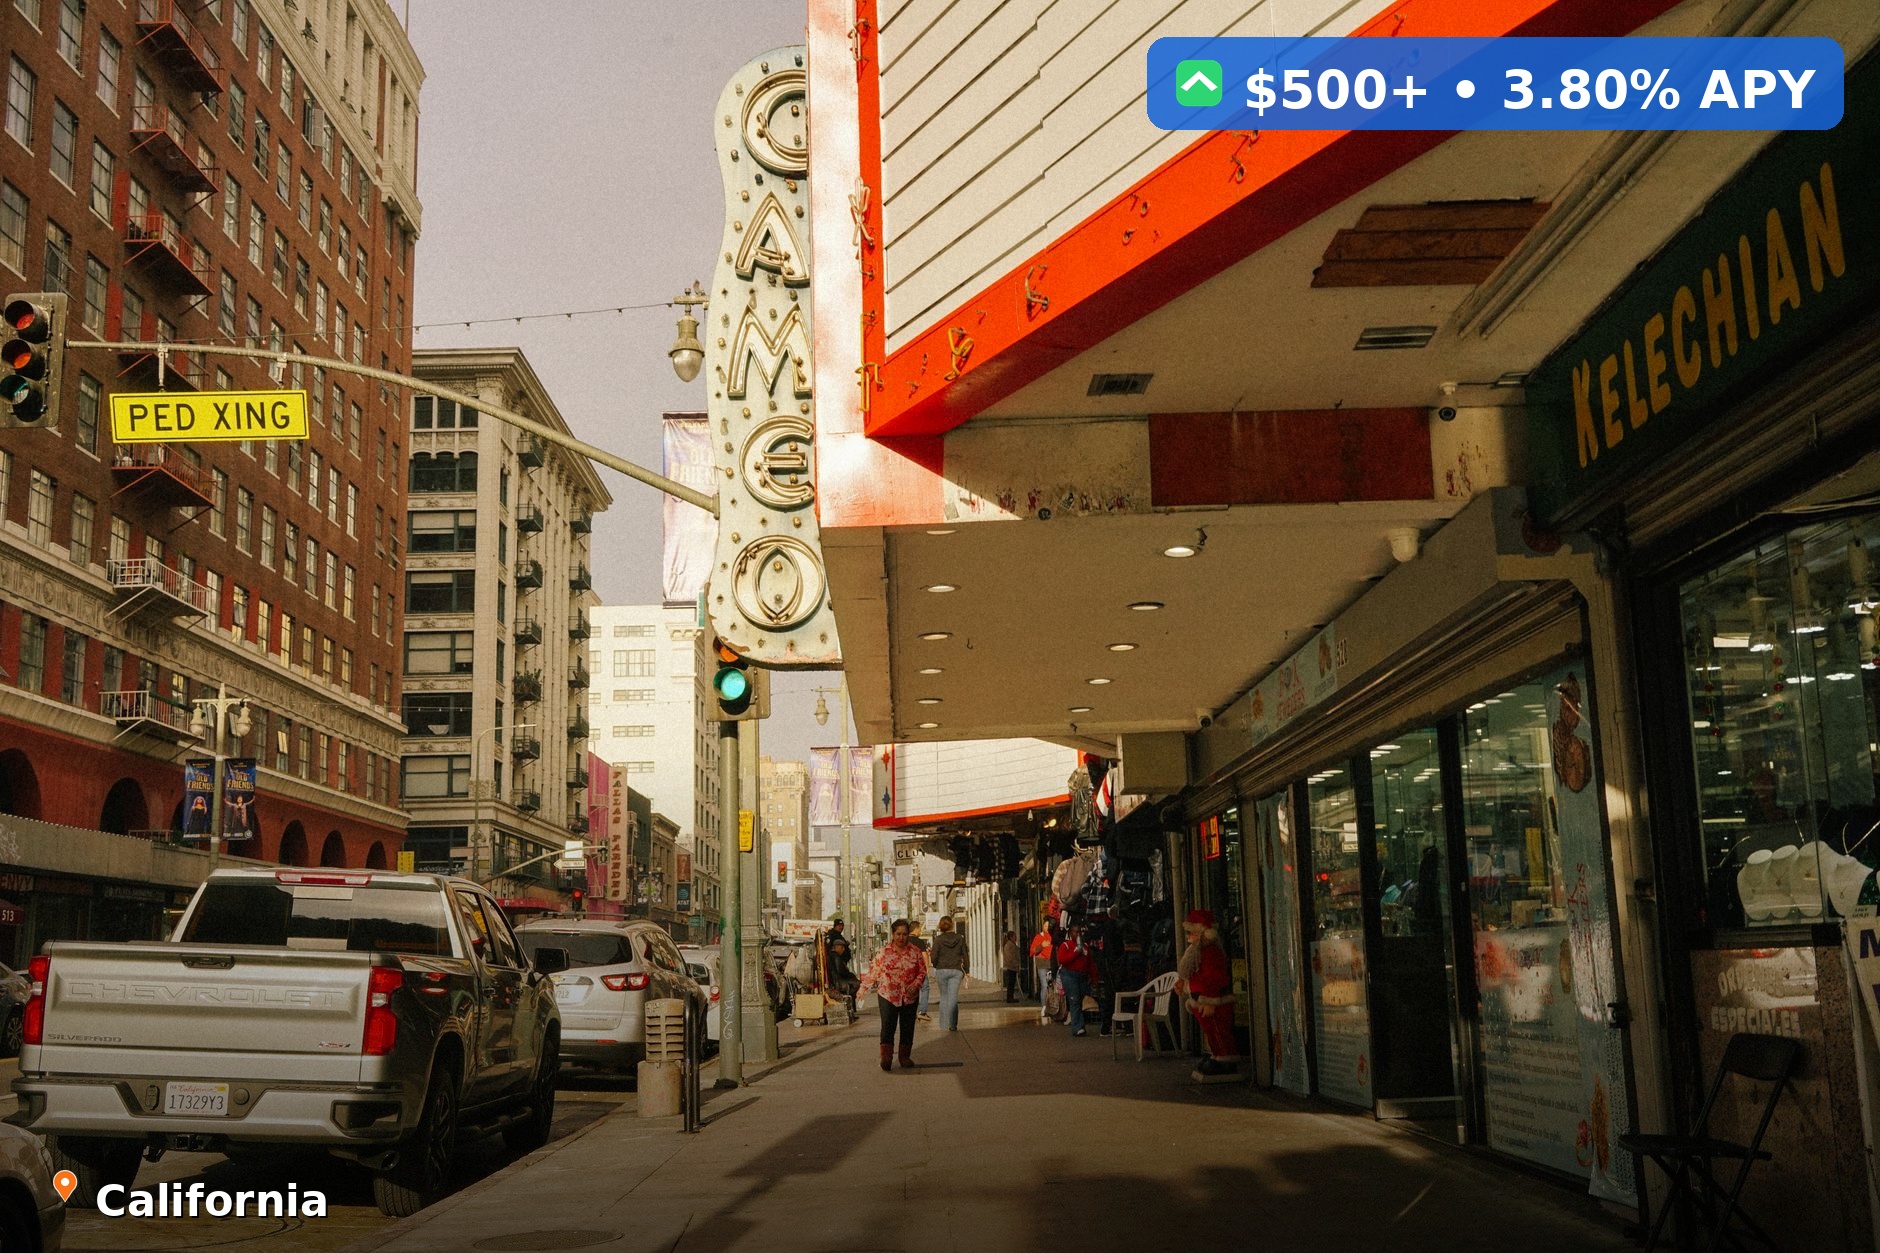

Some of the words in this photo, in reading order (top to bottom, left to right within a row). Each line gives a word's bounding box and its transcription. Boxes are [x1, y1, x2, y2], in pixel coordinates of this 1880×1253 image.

[1572, 161, 1846, 469] KELECHIAN
[727, 69, 827, 631] CAMEO
[129, 402, 195, 433] PED
[213, 400, 291, 429] XING
[227, 779, 254, 790] FRIENDS
[2, 909, 15, 922] 513
[68, 981, 344, 1008] CHEVROLET
[1711, 1006, 1801, 1039] ESPECIALES
[47, 1033, 122, 1042] SILVERADO
[169, 1094, 224, 1111] 17329Y3
